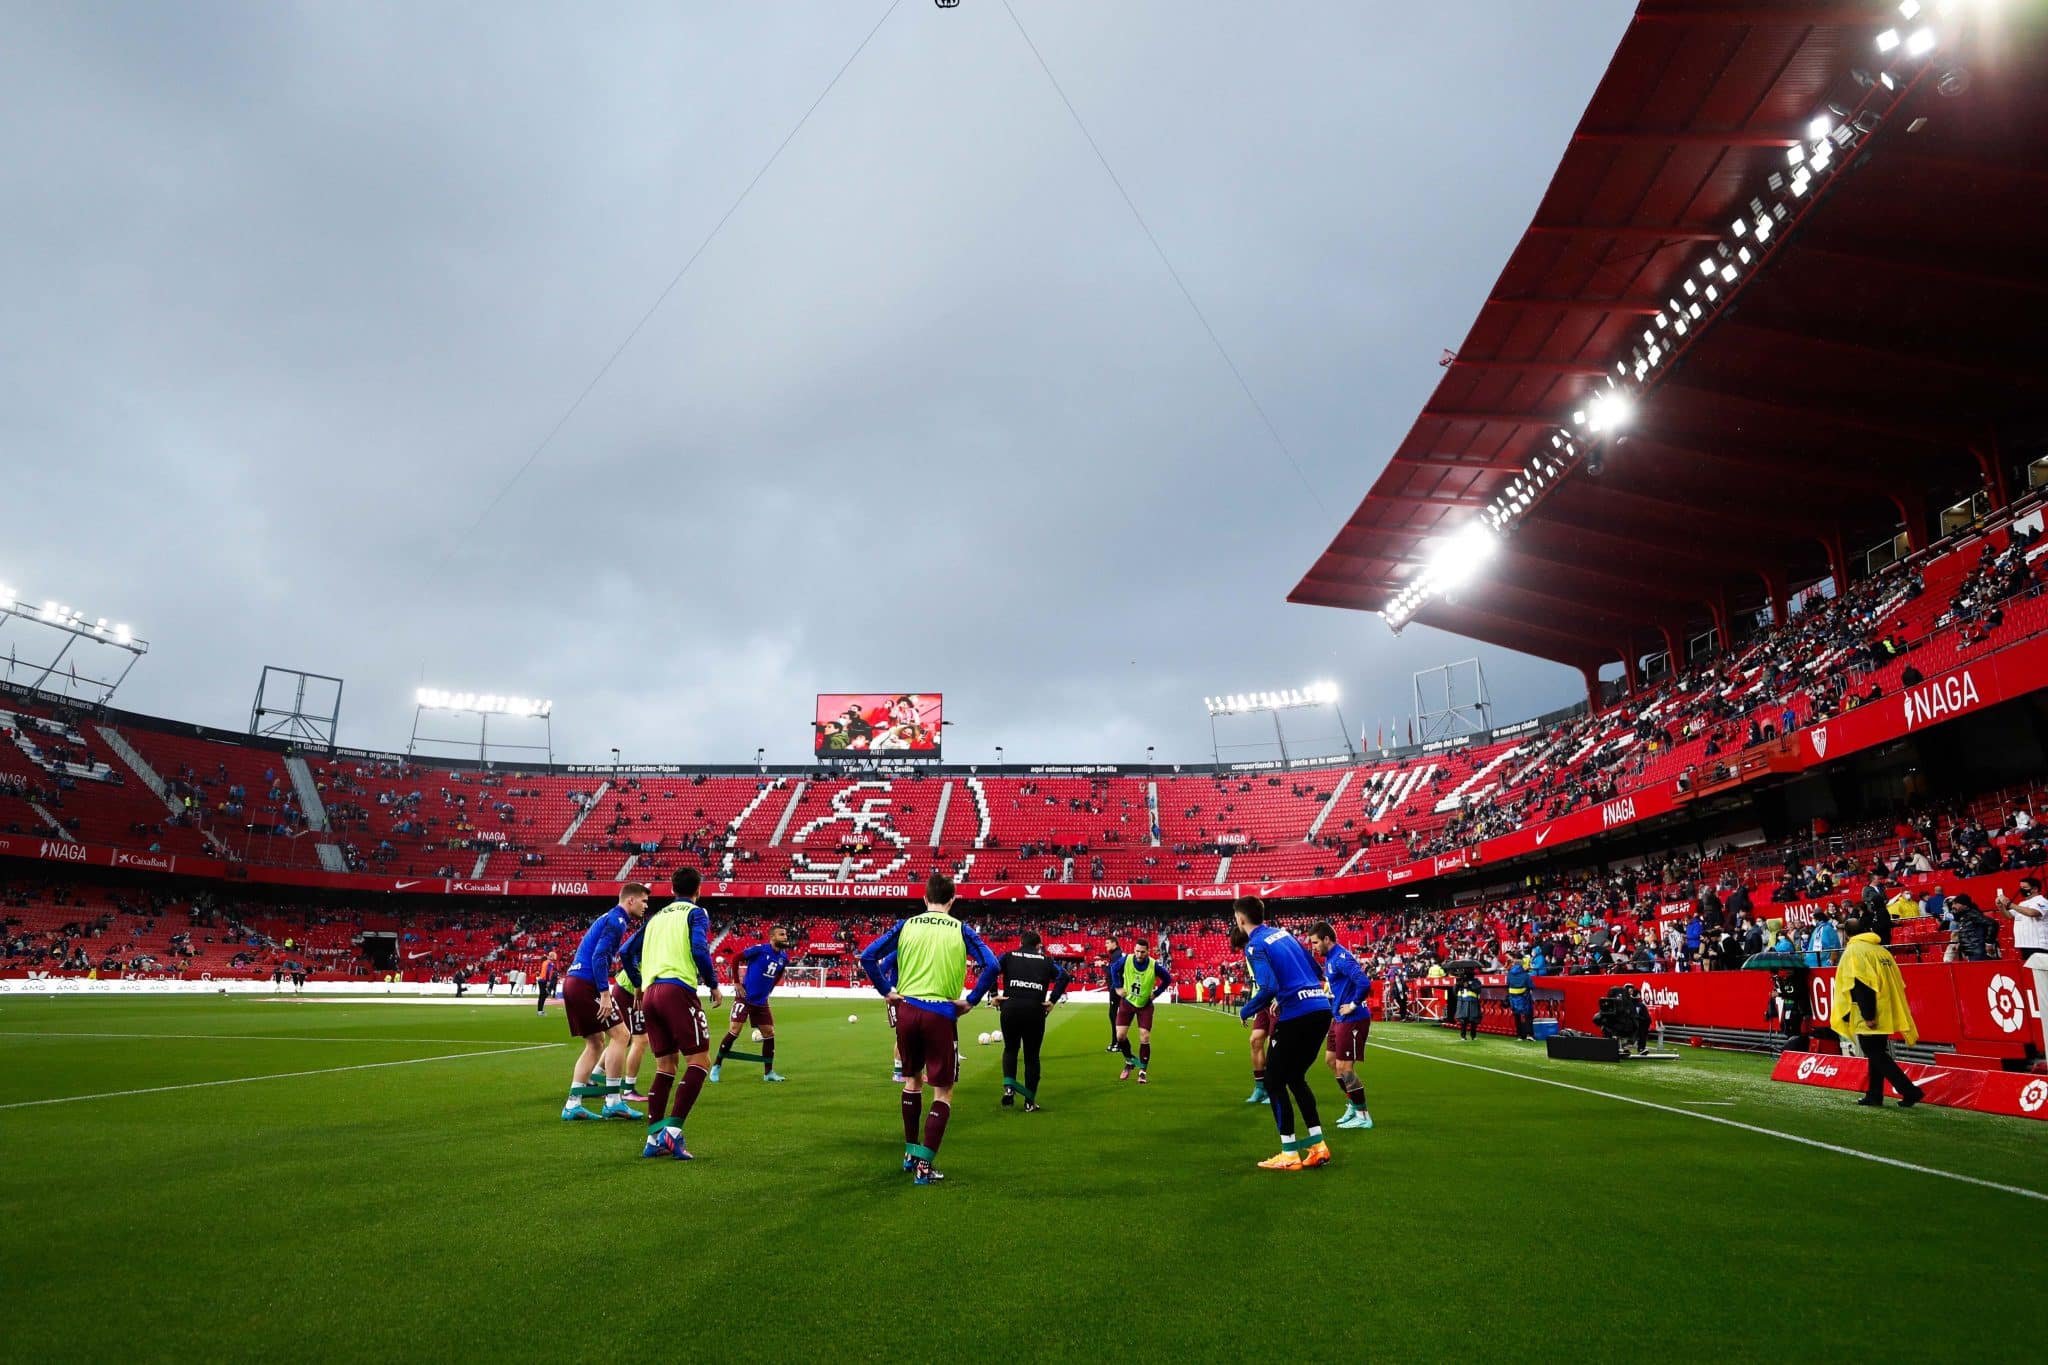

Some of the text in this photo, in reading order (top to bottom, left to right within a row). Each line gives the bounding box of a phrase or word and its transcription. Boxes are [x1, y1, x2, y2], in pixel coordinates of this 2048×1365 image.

[37, 690, 58, 702] hasta
[68, 699, 94, 711] muerte
[1914, 671, 1979, 723] NAGA
[303, 743, 328, 752] Giralda
[336, 748, 400, 760] presume orgullosa
[894, 765, 915, 773] Sevilla
[1072, 765, 1095, 773] contigo
[1096, 765, 1117, 773] Sevilla
[1231, 761, 1274, 770] compartiendo
[1608, 797, 1636, 825] NAGA
[482, 832, 506, 841] NAGA
[847, 835, 869, 844] NAGA
[1223, 834, 1246, 844] NAGA
[49, 842, 87, 861] NAGA
[130, 854, 168, 868] CaixaBank
[464, 883, 501, 892] CaixaBank
[557, 882, 589, 894] NAGA
[765, 884, 908, 897] FORZA SEVILLA CAMPEON
[1099, 885, 1132, 898] NAGA
[1195, 888, 1233, 897] CaixaBank
[910, 916, 958, 929] macron
[1010, 979, 1043, 991] macron
[1653, 987, 1680, 1009] LaLiga
[1813, 1064, 1839, 1078] LaLiga
